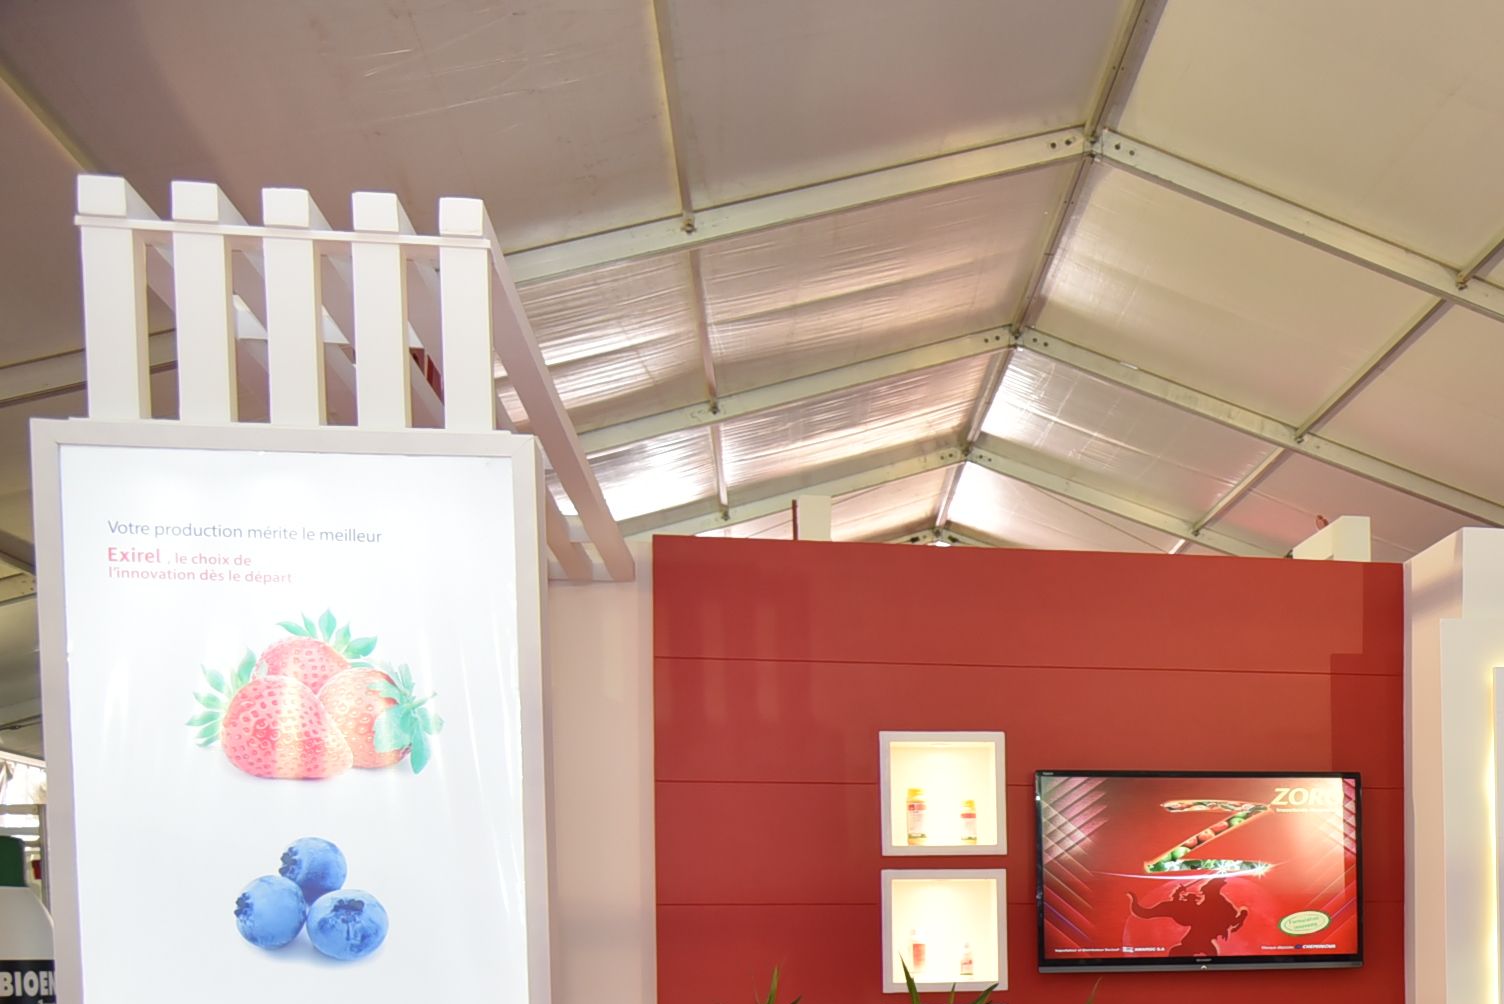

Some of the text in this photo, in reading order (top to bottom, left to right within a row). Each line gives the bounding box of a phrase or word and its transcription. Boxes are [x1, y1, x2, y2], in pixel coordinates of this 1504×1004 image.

[107, 520, 382, 543] Votre production mérite le meilleur
[107, 546, 161, 564] Exirel
[175, 552, 188, 565] le
[191, 551, 230, 566] choix
[233, 552, 252, 567] de
[108, 566, 292, 587] l'innovation dès le départ
